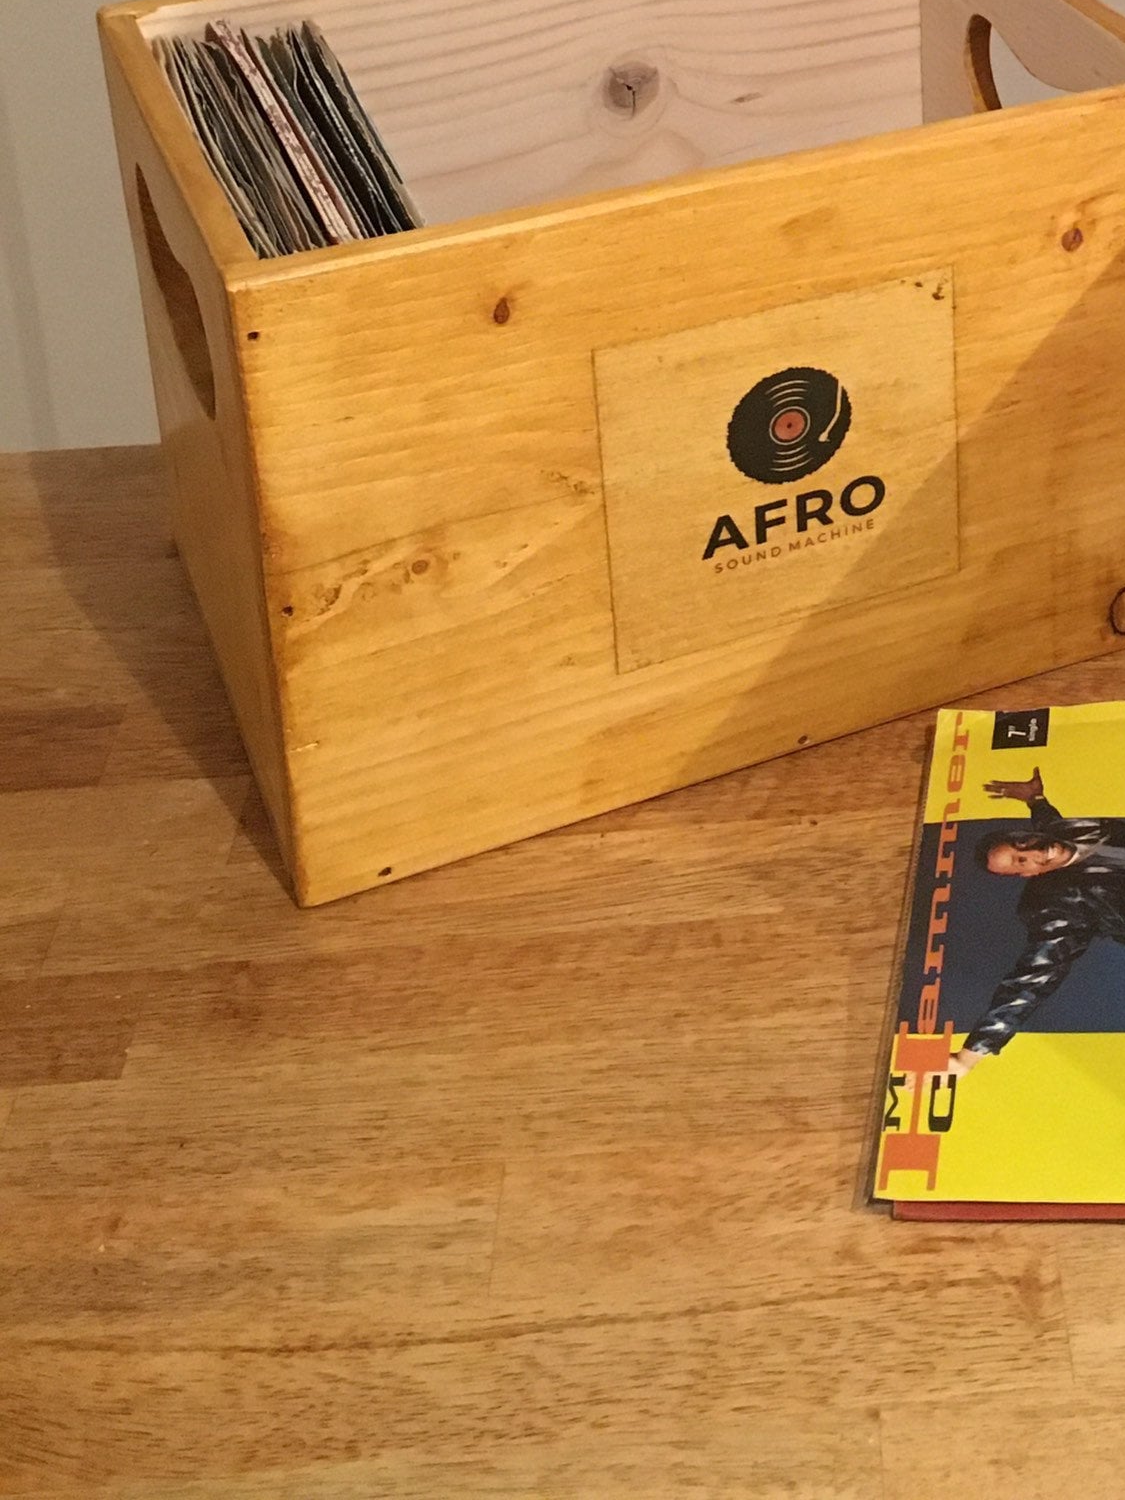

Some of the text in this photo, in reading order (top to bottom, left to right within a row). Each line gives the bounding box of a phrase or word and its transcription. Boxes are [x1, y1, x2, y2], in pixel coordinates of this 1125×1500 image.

[701, 475, 885, 560] AFRO
[715, 519, 876, 574] SOUND MACHINE
[878, 712, 969, 1191] Hammer
